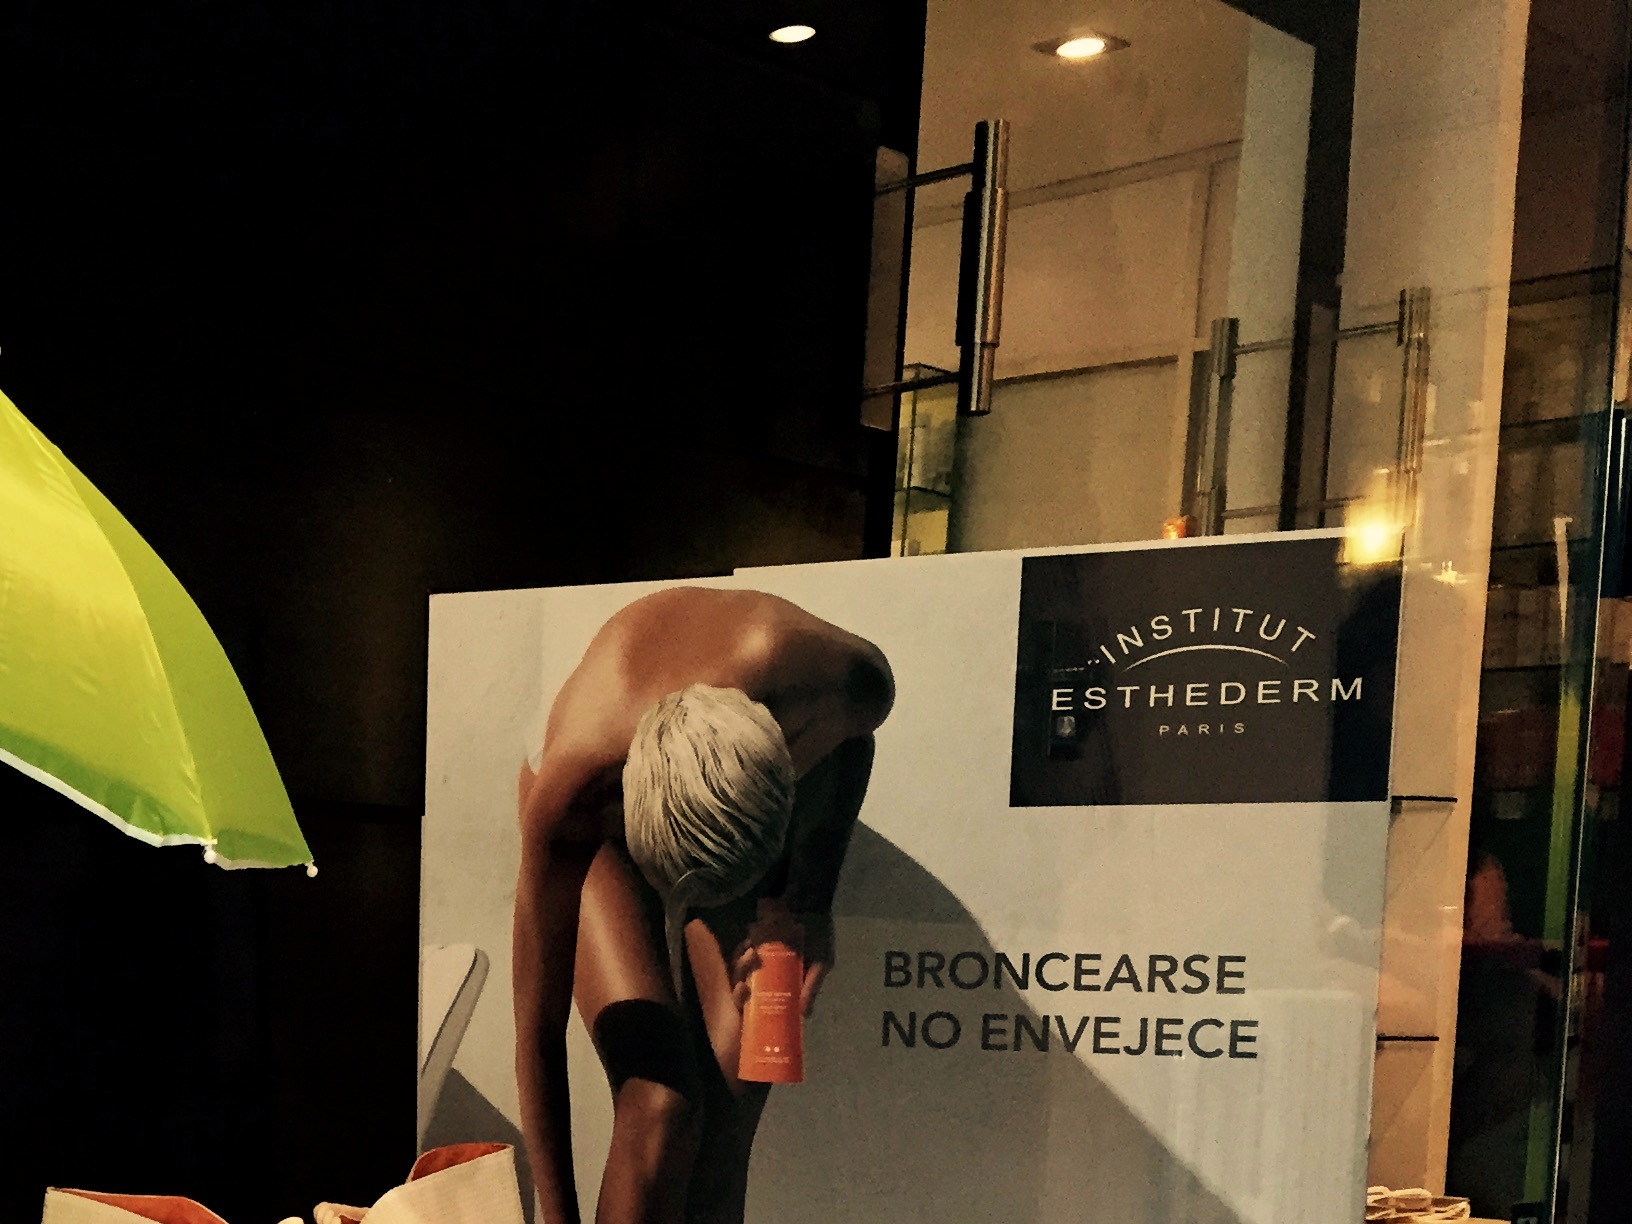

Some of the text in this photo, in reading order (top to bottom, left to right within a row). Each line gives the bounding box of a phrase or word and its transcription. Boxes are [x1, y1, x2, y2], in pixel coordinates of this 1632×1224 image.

[1099, 607, 1317, 665] INSTITUT
[1051, 676, 1364, 712] ESTHEDERM
[1159, 722, 1246, 737] PARIS
[883, 951, 1247, 995] BRONCEARSE
[881, 1010, 1259, 1059] NO ENVEJECE
